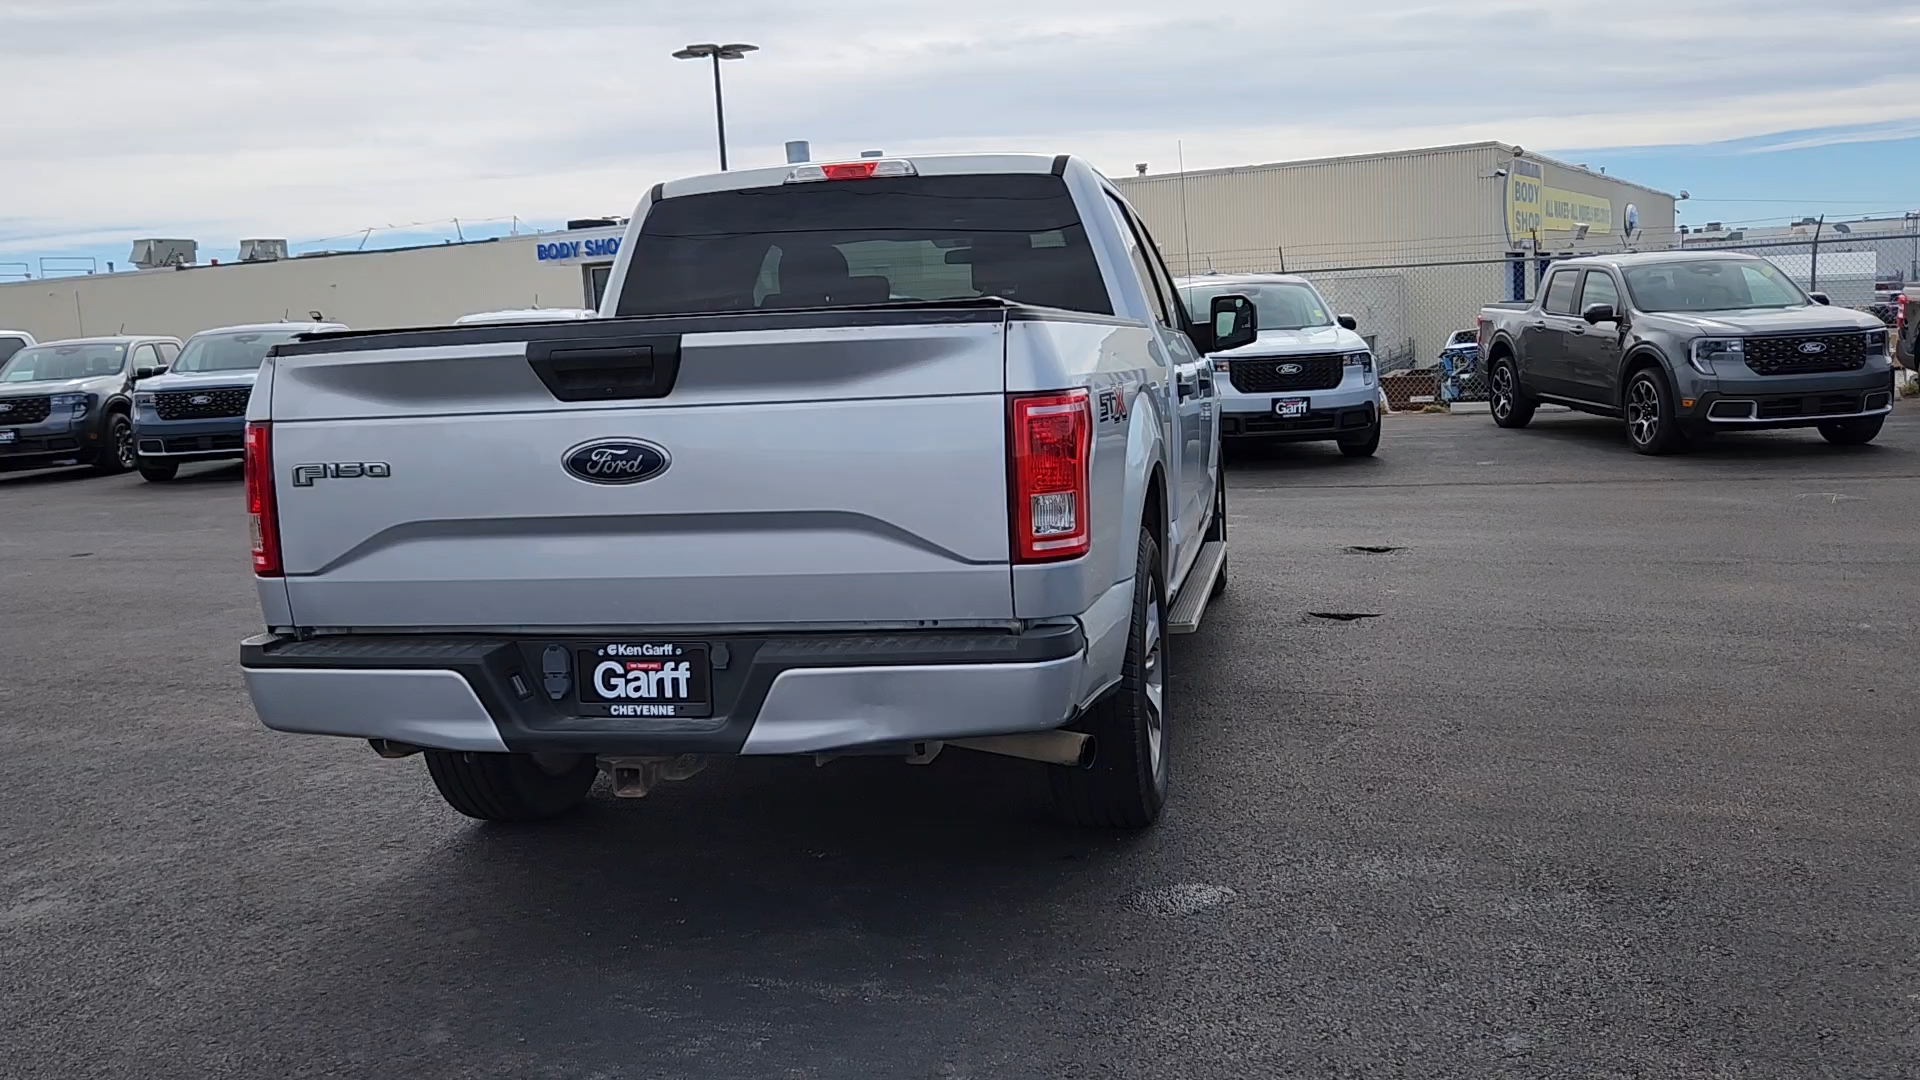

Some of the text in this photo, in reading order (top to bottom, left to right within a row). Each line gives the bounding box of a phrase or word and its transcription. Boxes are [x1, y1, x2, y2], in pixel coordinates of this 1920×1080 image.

[1515, 181, 1540, 204] BODY
[1515, 210, 1540, 232] SHOP
[537, 241, 581, 261] BODY
[1275, 401, 1308, 415] Garff
[586, 448, 643, 474] Ford
[618, 643, 673, 656] Ken Garff
[593, 661, 690, 699] Garff
[610, 705, 675, 716] CHEYENNE
